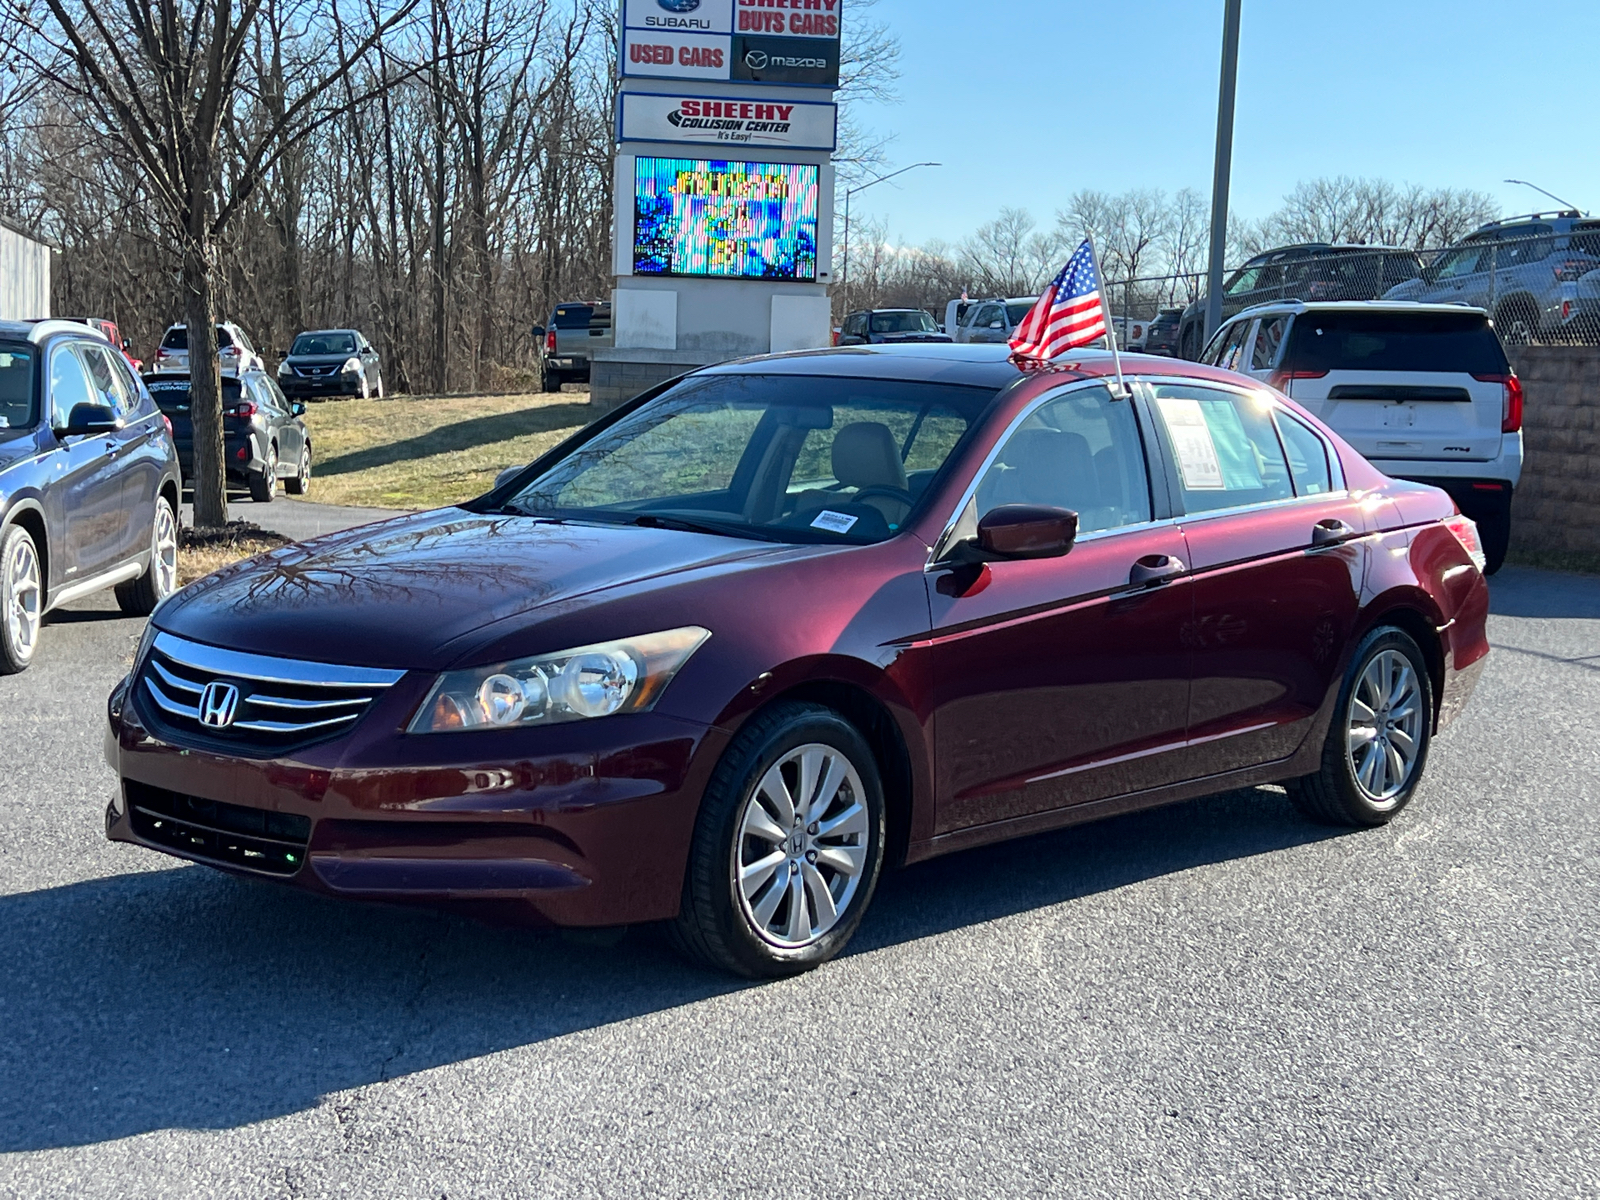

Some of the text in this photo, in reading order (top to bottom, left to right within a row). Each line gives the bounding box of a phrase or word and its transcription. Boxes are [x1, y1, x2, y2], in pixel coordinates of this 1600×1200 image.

[645, 16, 710, 29] SUBARU
[738, 9, 838, 36] BUYS CARS
[630, 43, 724, 68] USED CARS
[681, 100, 794, 121] SHEEHY
[681, 118, 791, 133] COLLISION CENTER
[717, 131, 752, 142] It's Easy!
